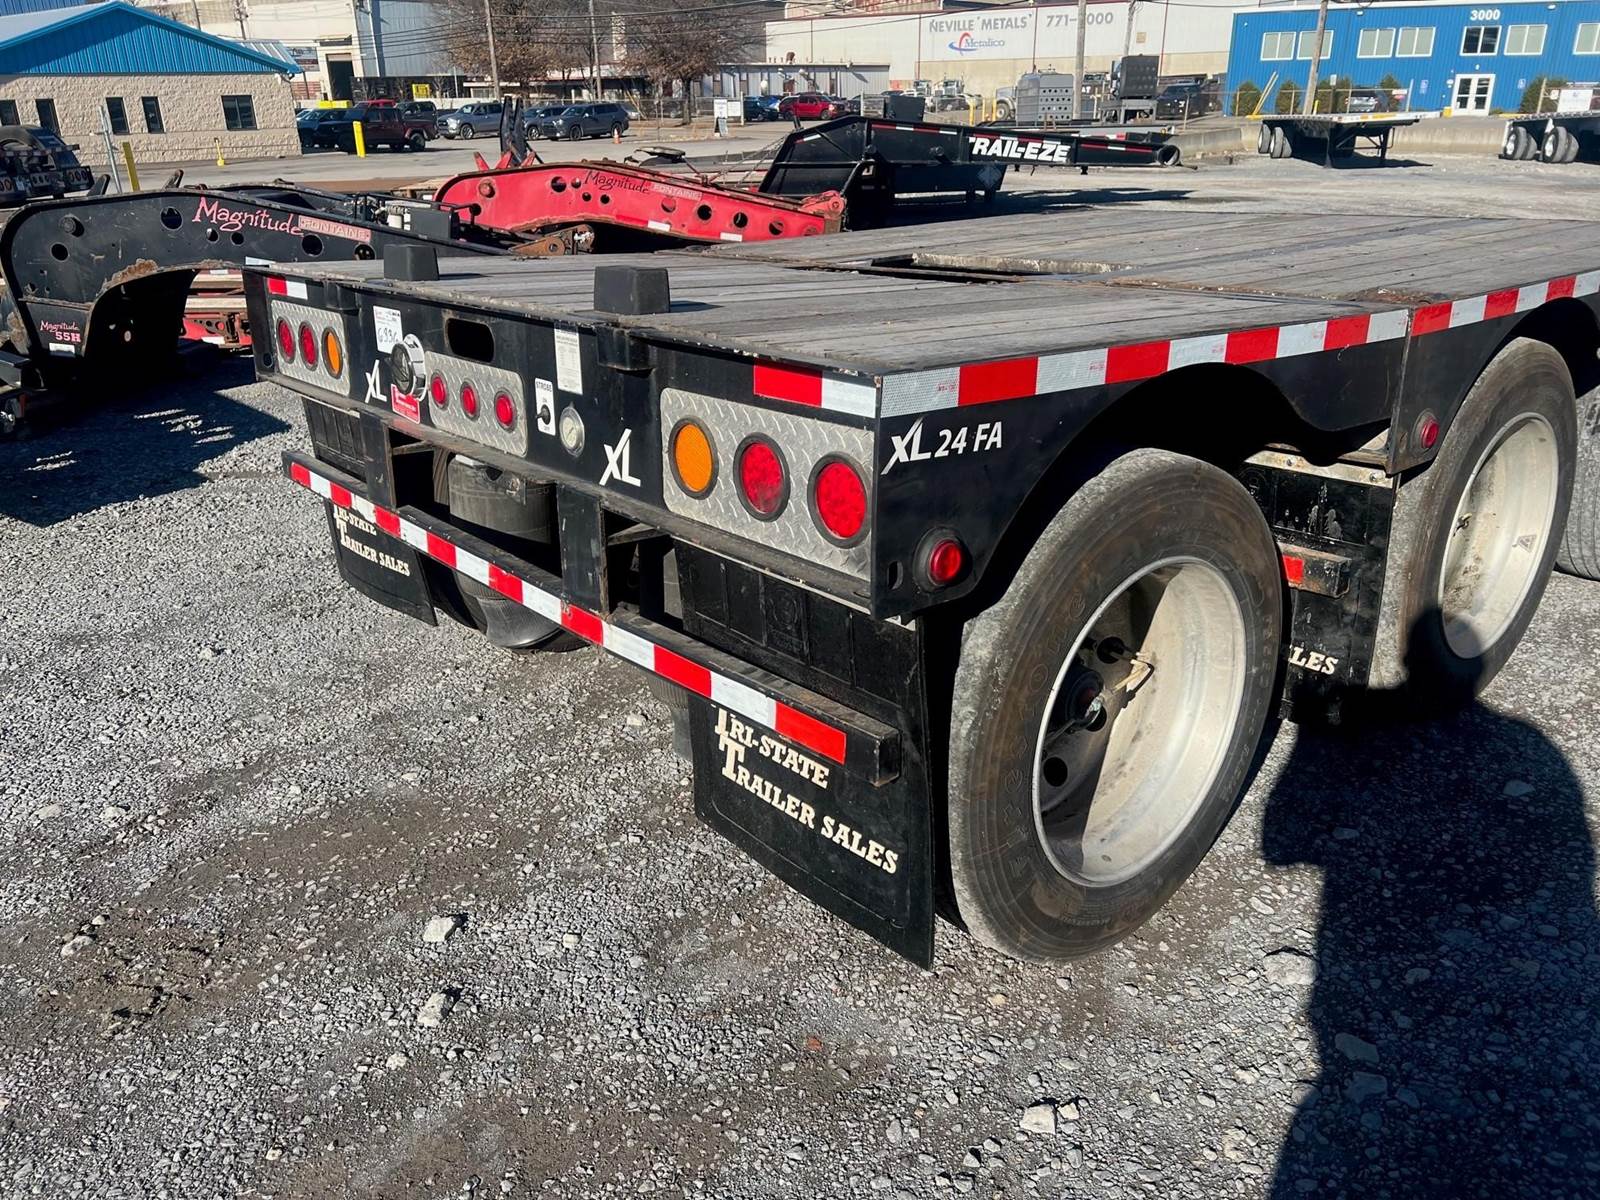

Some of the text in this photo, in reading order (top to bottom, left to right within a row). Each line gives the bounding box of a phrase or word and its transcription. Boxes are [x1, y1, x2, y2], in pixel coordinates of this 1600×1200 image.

[929, 16, 1028, 33] NEVILLE METALS
[1046, 12, 1114, 27] 771-000
[1470, 9, 1501, 21] 3000
[964, 37, 1005, 48] Metalico
[584, 170, 650, 195] Magnitude
[192, 196, 366, 241] Magnitude FONTAINE
[40, 320, 80, 332] Magnitude
[364, 359, 387, 404] XL
[535, 381, 552, 392] STROBE
[599, 428, 641, 487] XL
[881, 416, 1002, 475] XL 24 FA
[336, 517, 410, 577] TRAILER SALES
[718, 734, 899, 875] TRAILER SALES
